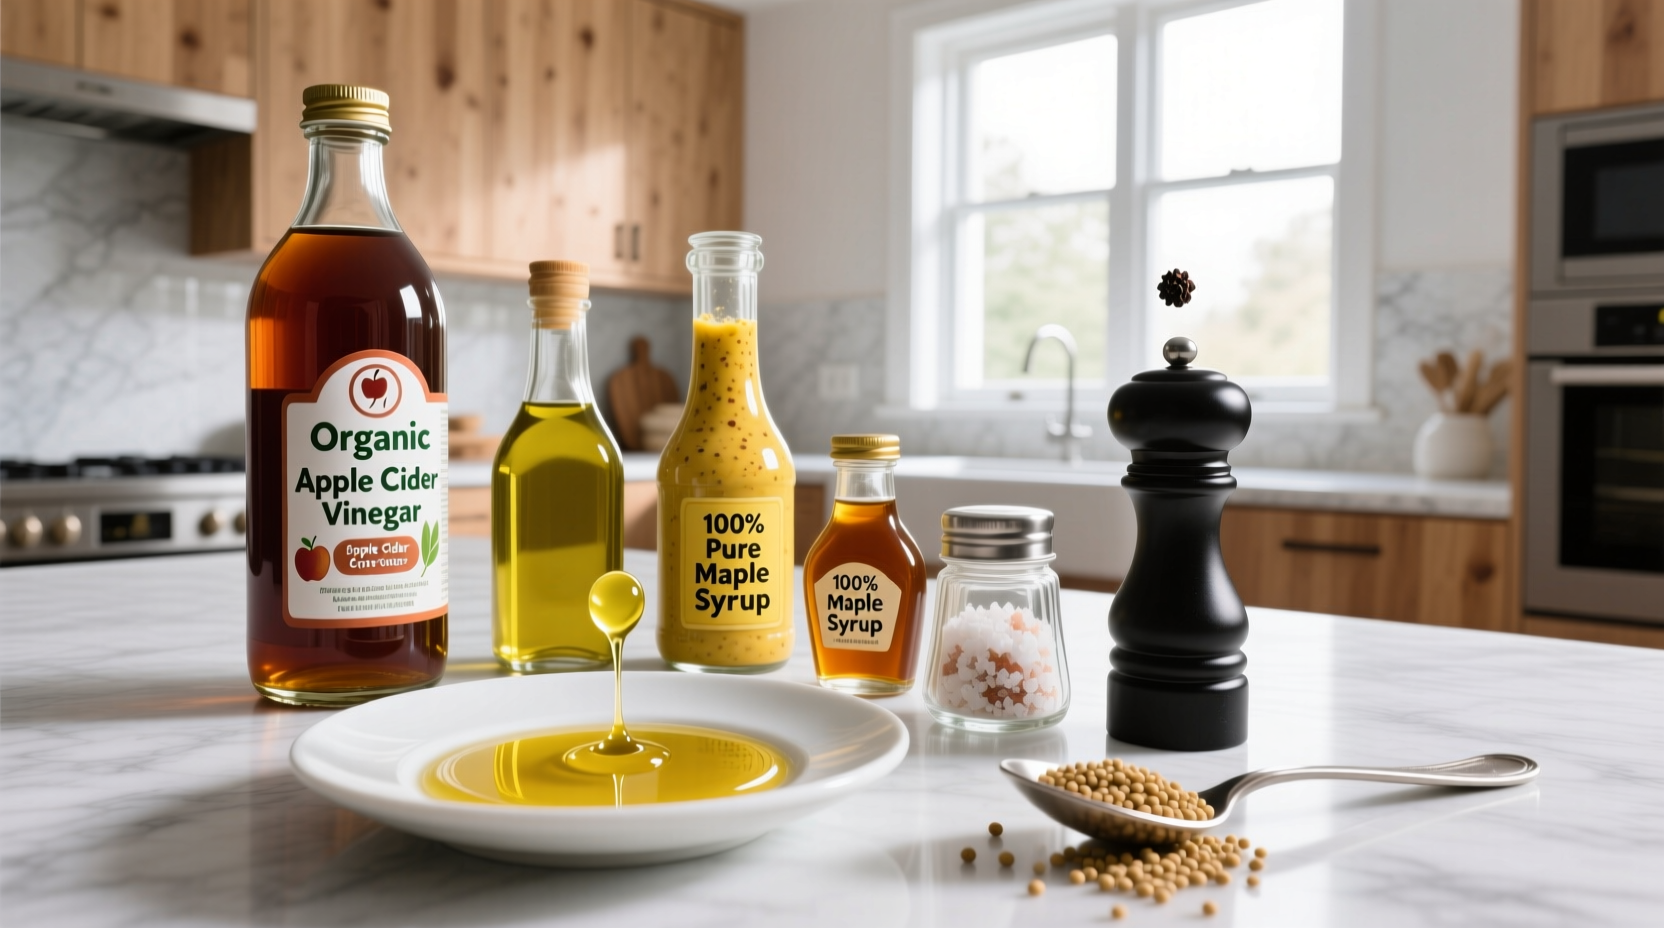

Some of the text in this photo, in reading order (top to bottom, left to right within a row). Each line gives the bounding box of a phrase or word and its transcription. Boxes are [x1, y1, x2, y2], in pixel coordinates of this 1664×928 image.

[310, 421, 430, 460] Organic
[294, 466, 438, 500] Apple Cider
[321, 501, 421, 531] Vinegar
[703, 513, 764, 534] 100%
[706, 538, 761, 559] Pure
[695, 562, 769, 590] Maple
[832, 574, 878, 591] 100%
[695, 588, 770, 618] Syrup
[827, 593, 883, 616] Maple
[827, 614, 883, 637] Syrup
